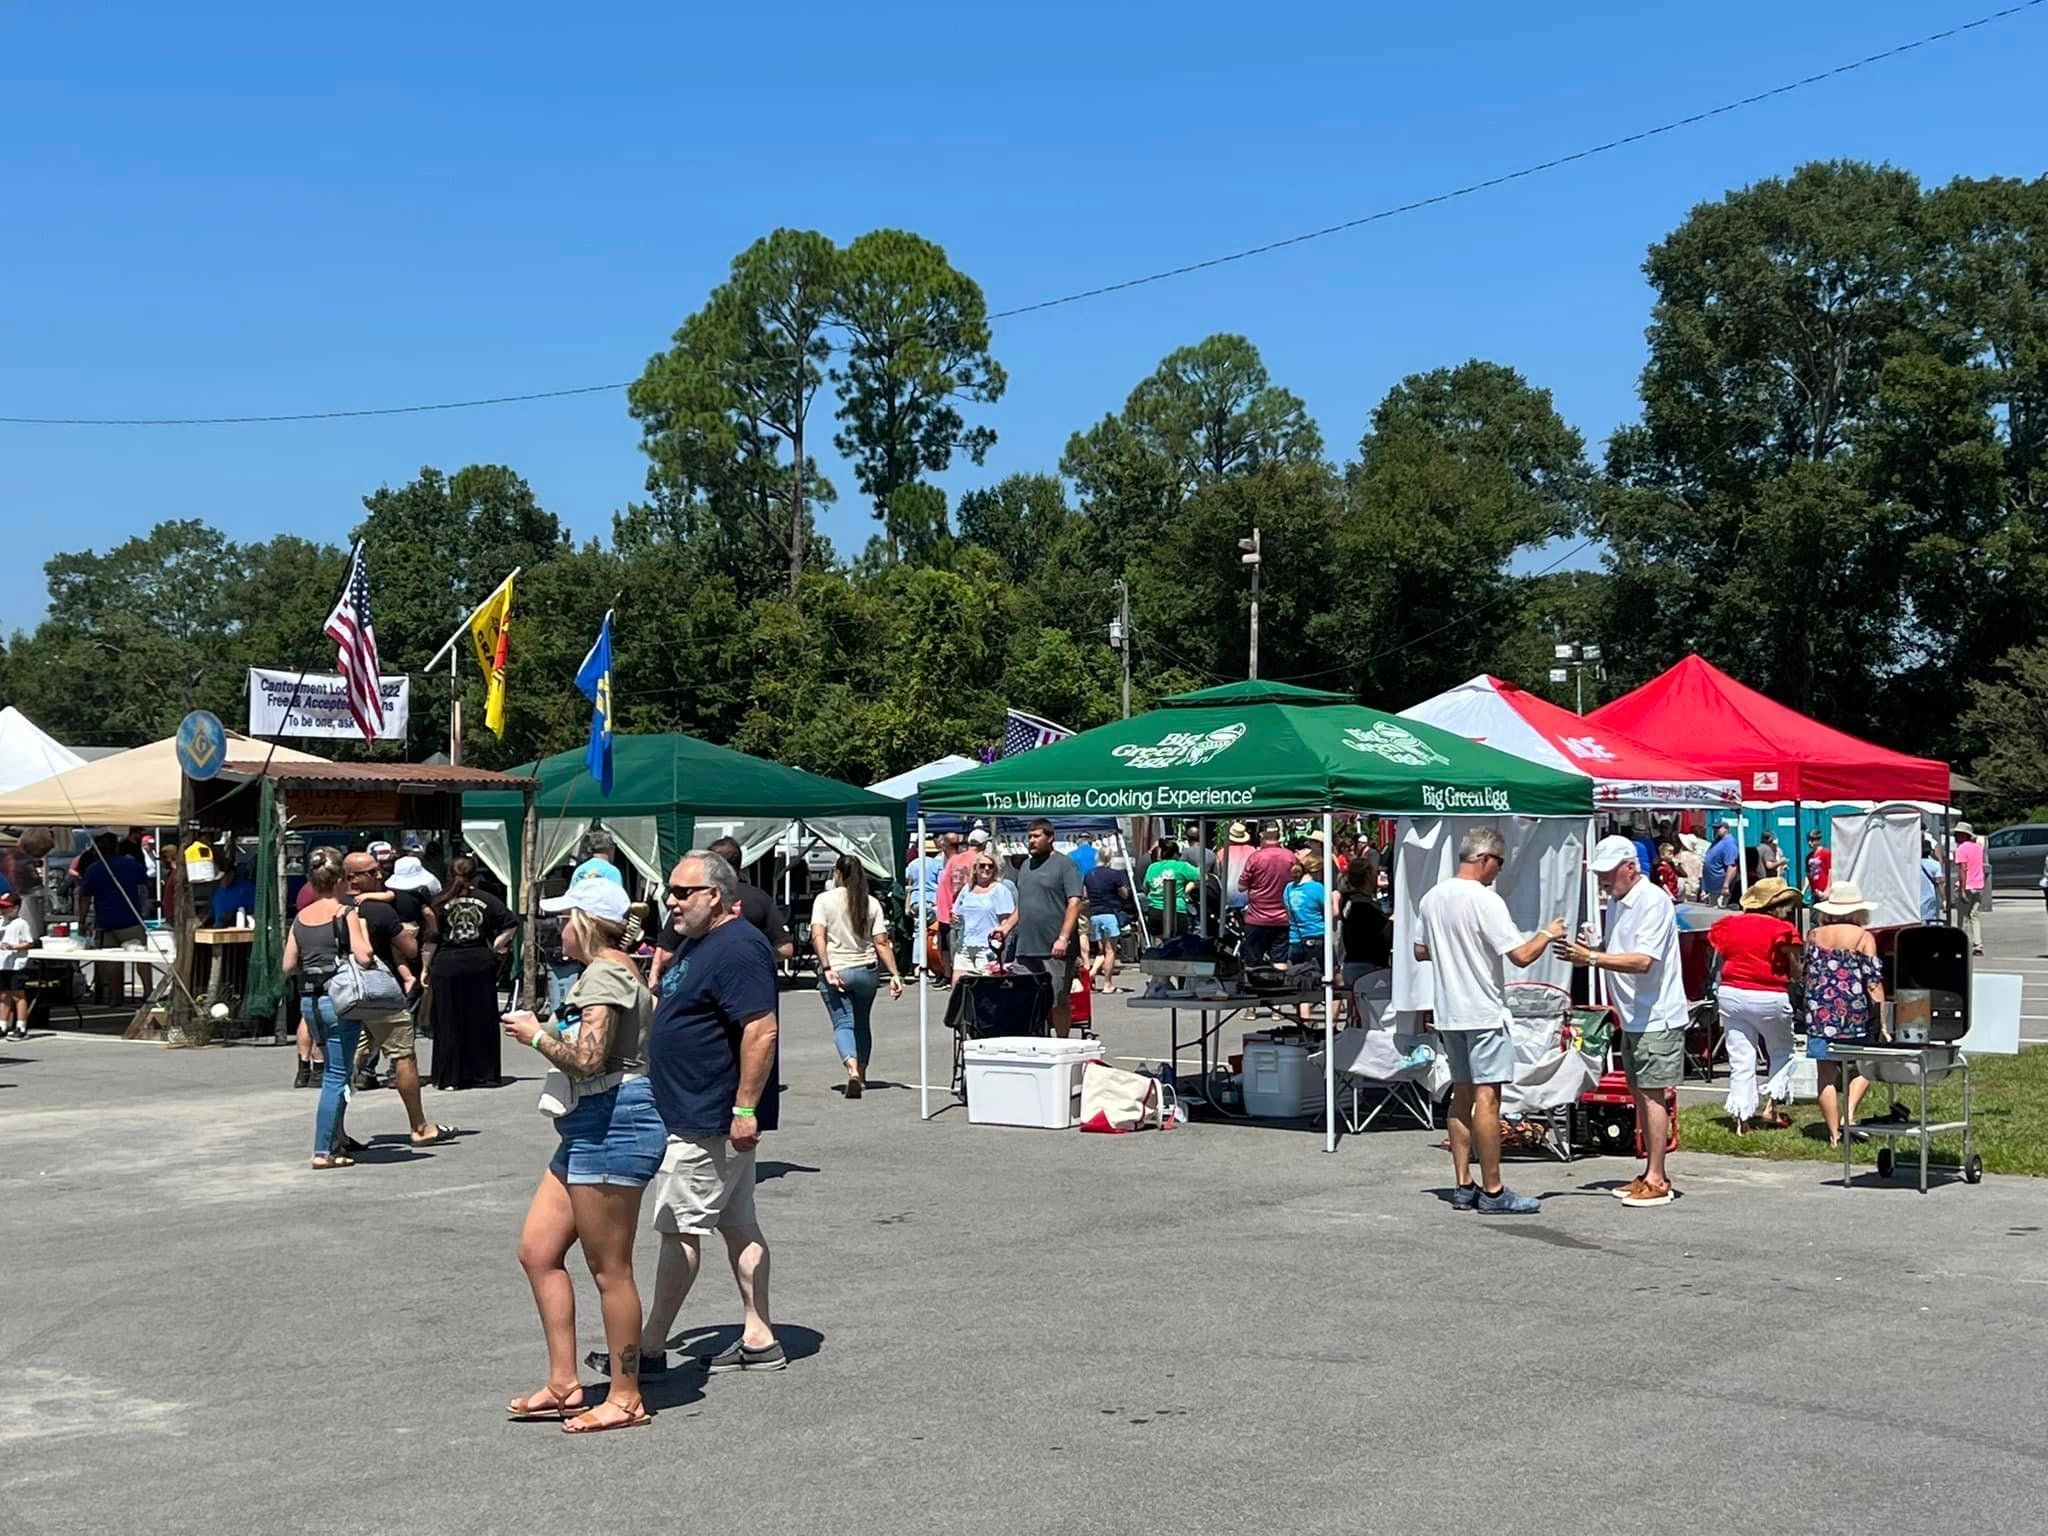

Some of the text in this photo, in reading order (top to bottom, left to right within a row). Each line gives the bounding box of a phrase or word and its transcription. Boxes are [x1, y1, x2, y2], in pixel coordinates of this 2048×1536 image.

[261, 678, 327, 695] Cantoment
[267, 693, 289, 707] Free
[288, 714, 299, 726] To
[301, 716, 313, 727] be
[337, 717, 355, 729] ask
[1156, 732, 1205, 747] Big
[1111, 744, 1189, 757] Green
[982, 791, 1013, 810] The
[1016, 791, 1081, 809] Ultimate
[1085, 788, 1153, 810] Cooking
[1421, 785, 1510, 811] Big Green Egg
